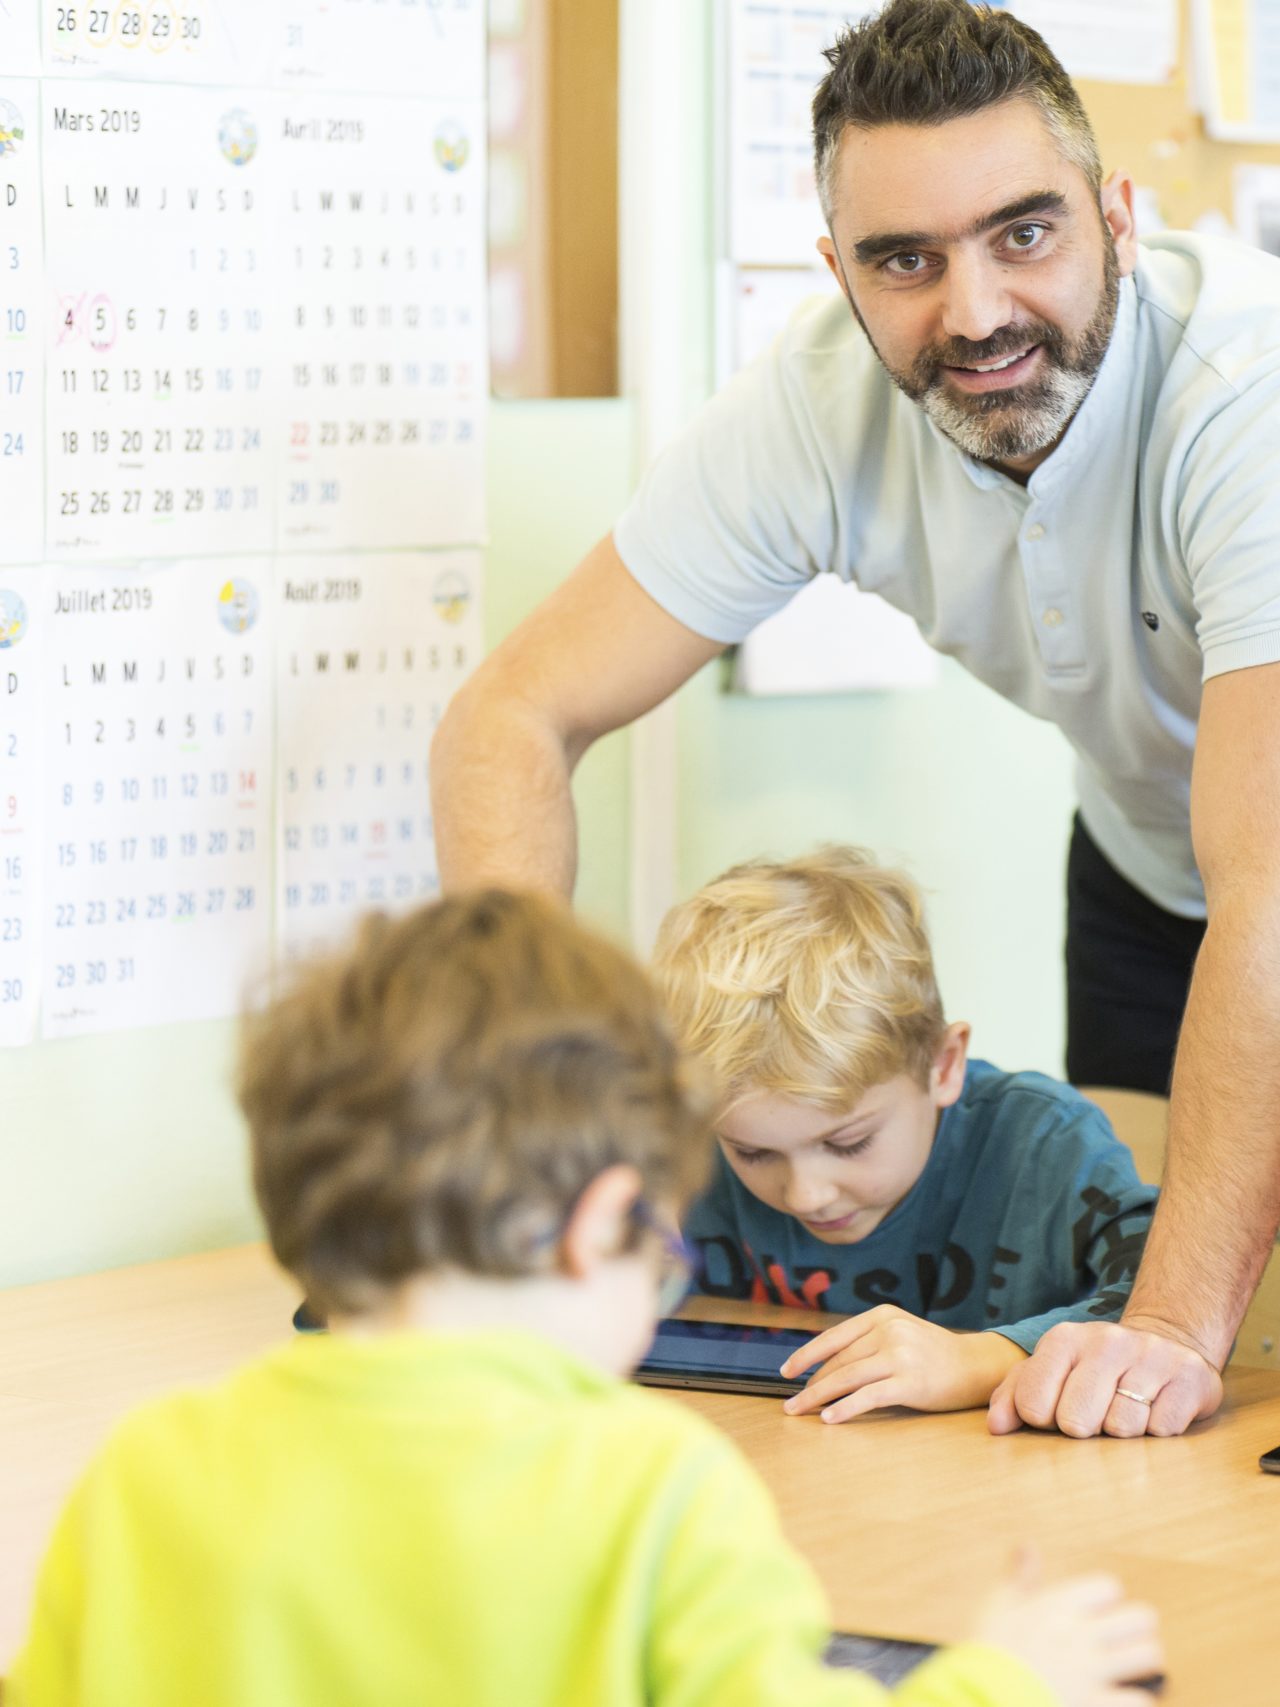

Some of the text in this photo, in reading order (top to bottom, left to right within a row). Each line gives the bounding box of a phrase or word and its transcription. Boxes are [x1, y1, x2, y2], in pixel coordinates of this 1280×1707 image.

[57, 8, 200, 38] 26 27 28 29 30
[54, 108, 141, 132] Mars 2019
[7, 184, 17, 207] D
[65, 185, 74, 208] L
[95, 186, 108, 208] M
[127, 187, 140, 208] M
[159, 187, 167, 210] J
[188, 188, 199, 210] V
[9, 247, 20, 269] 3
[218, 249, 228, 271] 2
[7, 309, 26, 332] 10
[64, 308, 73, 330] 4
[96, 308, 106, 331] 5
[127, 309, 136, 330] 6
[158, 309, 167, 330] 7
[188, 309, 199, 332] 8
[7, 370, 24, 394] 17
[62, 370, 77, 392] 11
[92, 369, 109, 392] 12
[123, 369, 141, 392] 13
[154, 370, 171, 392] 14
[185, 368, 204, 392] 15
[216, 369, 233, 392] 16
[4, 432, 24, 455] 24
[62, 427, 261, 454] 18 19 20 21 22 23 24
[61, 492, 79, 515] 25
[91, 492, 110, 514] 26
[123, 491, 142, 513] 27
[154, 490, 174, 512] 28
[184, 487, 204, 512] 29
[55, 588, 152, 613] Juillet 2019
[8, 672, 17, 694] D
[63, 664, 71, 686] L
[92, 662, 106, 683] M
[124, 661, 137, 683] M
[158, 659, 165, 682] J
[187, 657, 195, 680] V
[66, 722, 72, 745] 1
[95, 719, 104, 743] 2
[127, 718, 136, 742] 3
[157, 716, 165, 738] 4
[186, 713, 195, 738] 5
[8, 734, 17, 756] 2
[62, 769, 256, 806] 8 9 10 11 12 13 14
[7, 796, 17, 818] 9
[58, 827, 255, 867] 15 16 17 18 19 20 21
[6, 857, 22, 880] 16
[56, 884, 256, 928] 22 23 24 25 26 27 28
[3, 918, 22, 941] 23
[56, 957, 135, 988] 29 30 31
[3, 979, 22, 1002] 30
